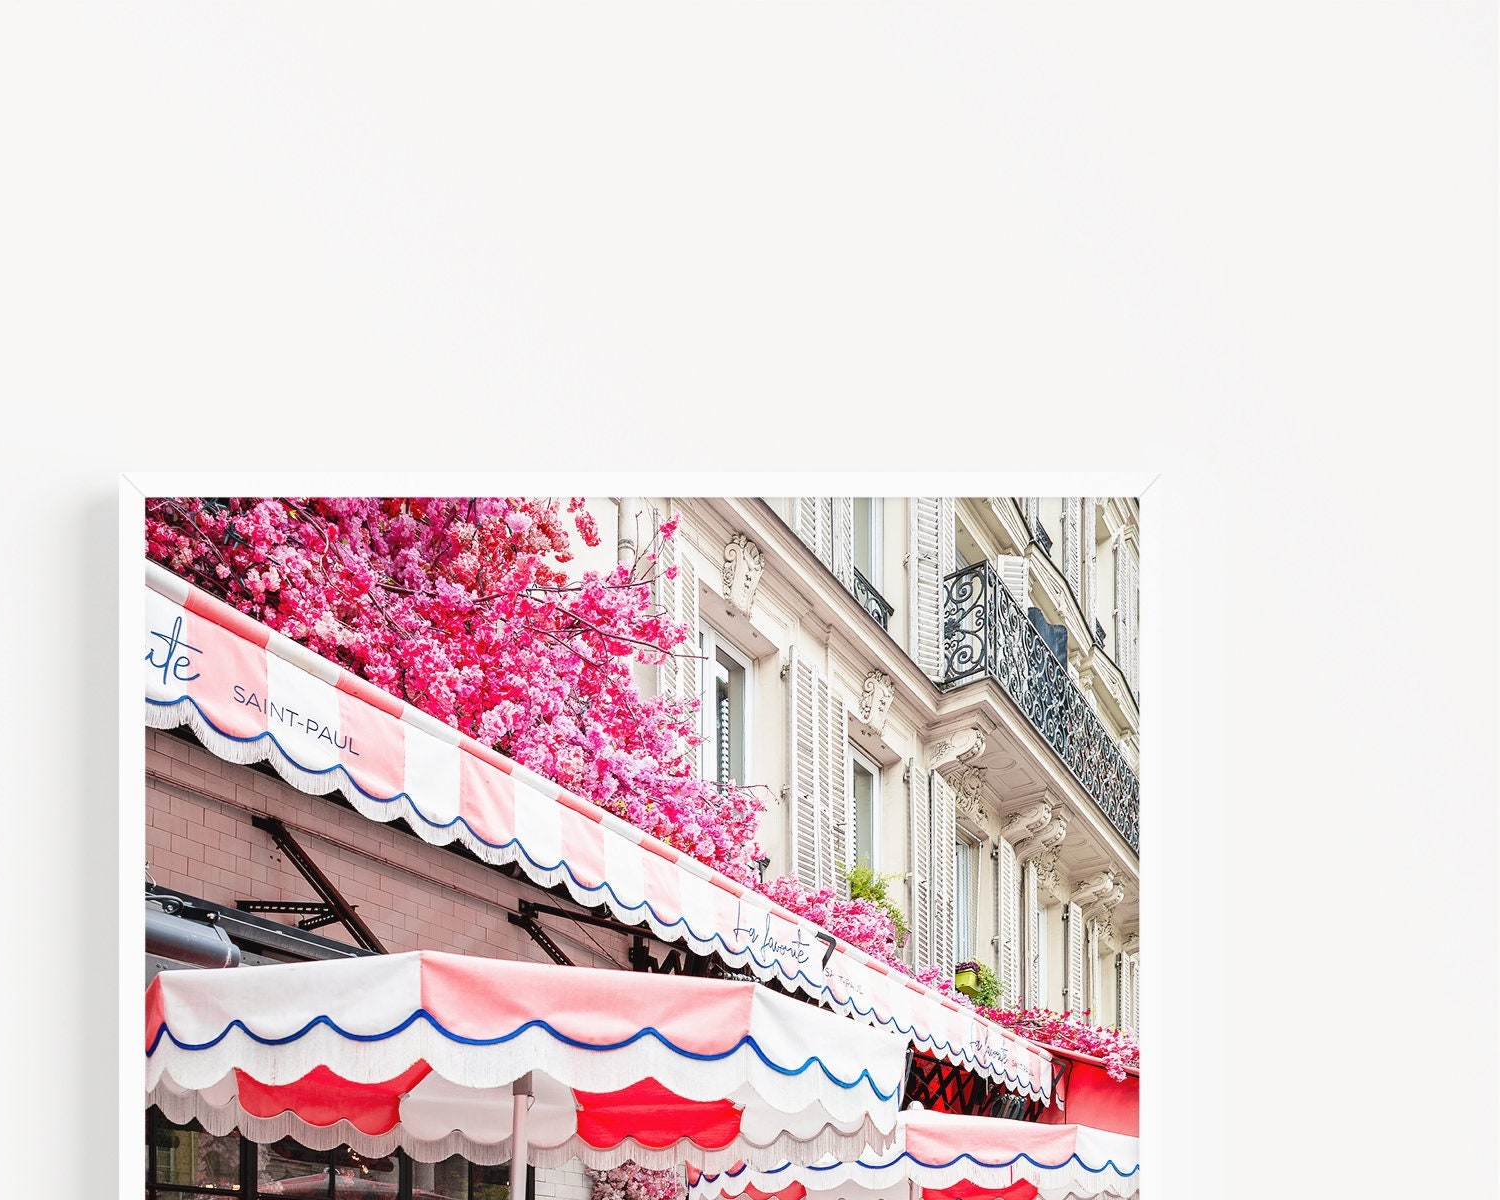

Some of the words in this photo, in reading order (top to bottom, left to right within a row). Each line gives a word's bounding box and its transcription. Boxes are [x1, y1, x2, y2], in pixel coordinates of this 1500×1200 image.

[233, 685, 360, 756] SAINT-PAUL
[733, 901, 759, 942] La
[760, 913, 810, 963] favorite
